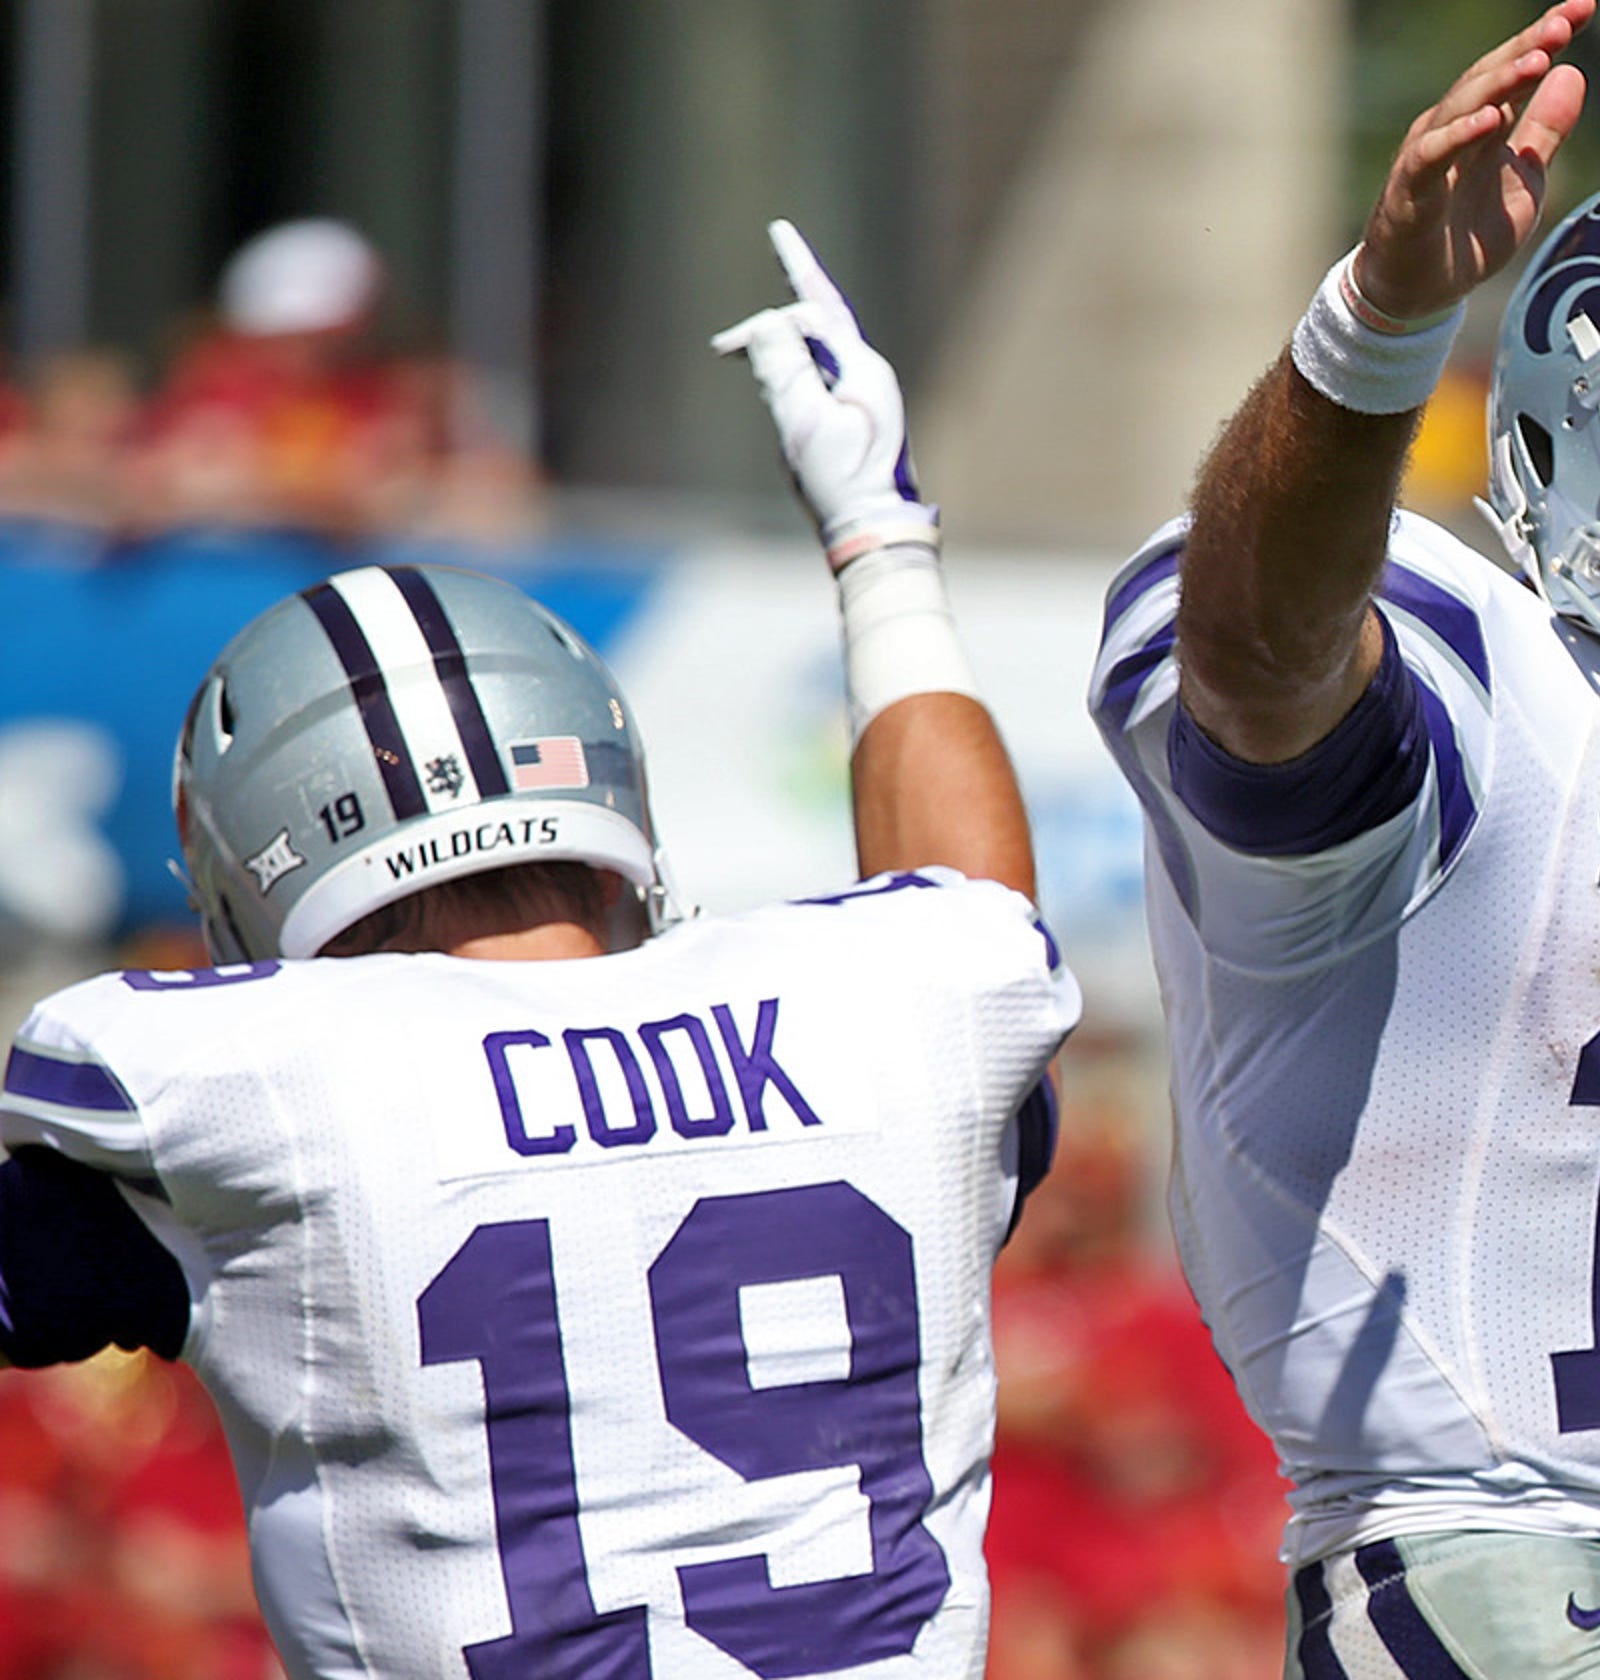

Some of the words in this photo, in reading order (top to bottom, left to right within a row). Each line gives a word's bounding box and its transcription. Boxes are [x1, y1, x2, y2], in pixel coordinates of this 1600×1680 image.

[319, 792, 366, 844] 19
[386, 817, 558, 880] WILDCATS
[482, 997, 823, 1157] COOK
[416, 1180, 953, 1680] 19
